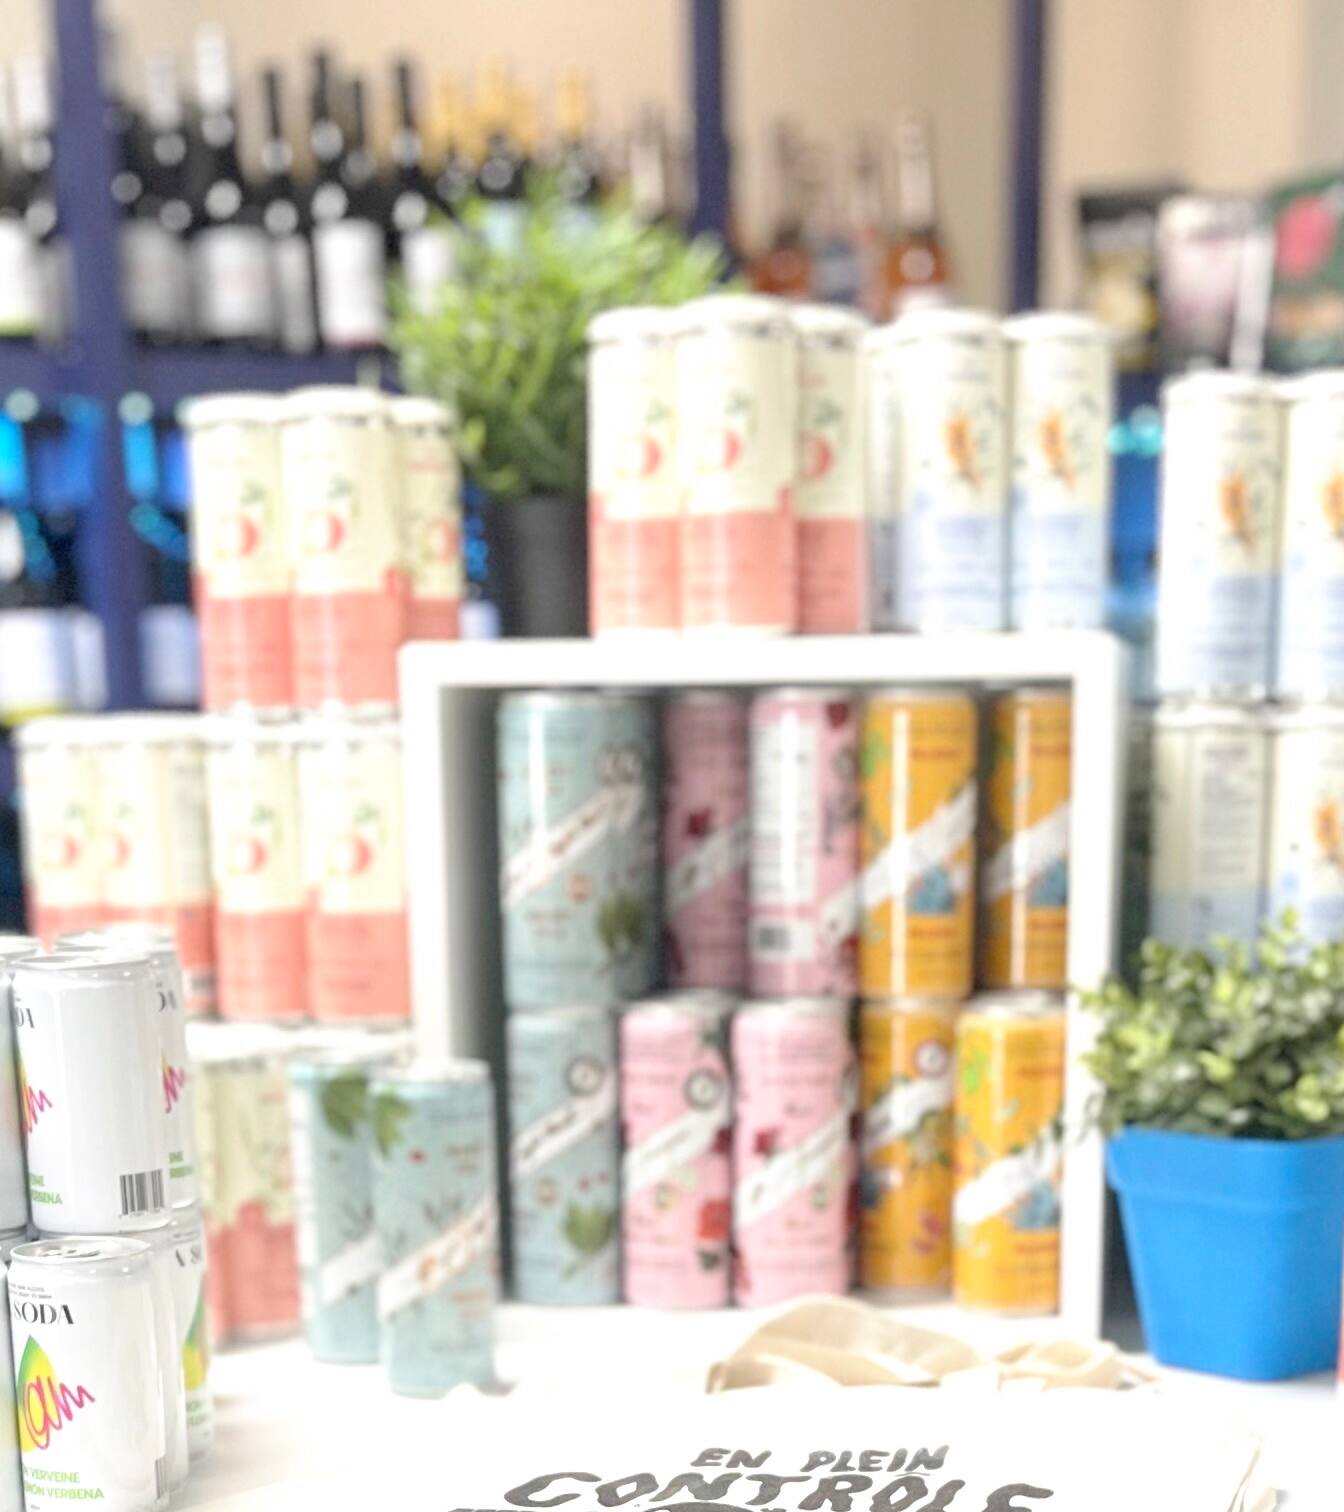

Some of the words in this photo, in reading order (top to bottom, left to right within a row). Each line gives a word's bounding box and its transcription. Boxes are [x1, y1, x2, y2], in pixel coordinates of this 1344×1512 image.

[14, 1301, 74, 1325] SODA
[690, 1447, 773, 1469] EN
[800, 1444, 949, 1473] PLEIN
